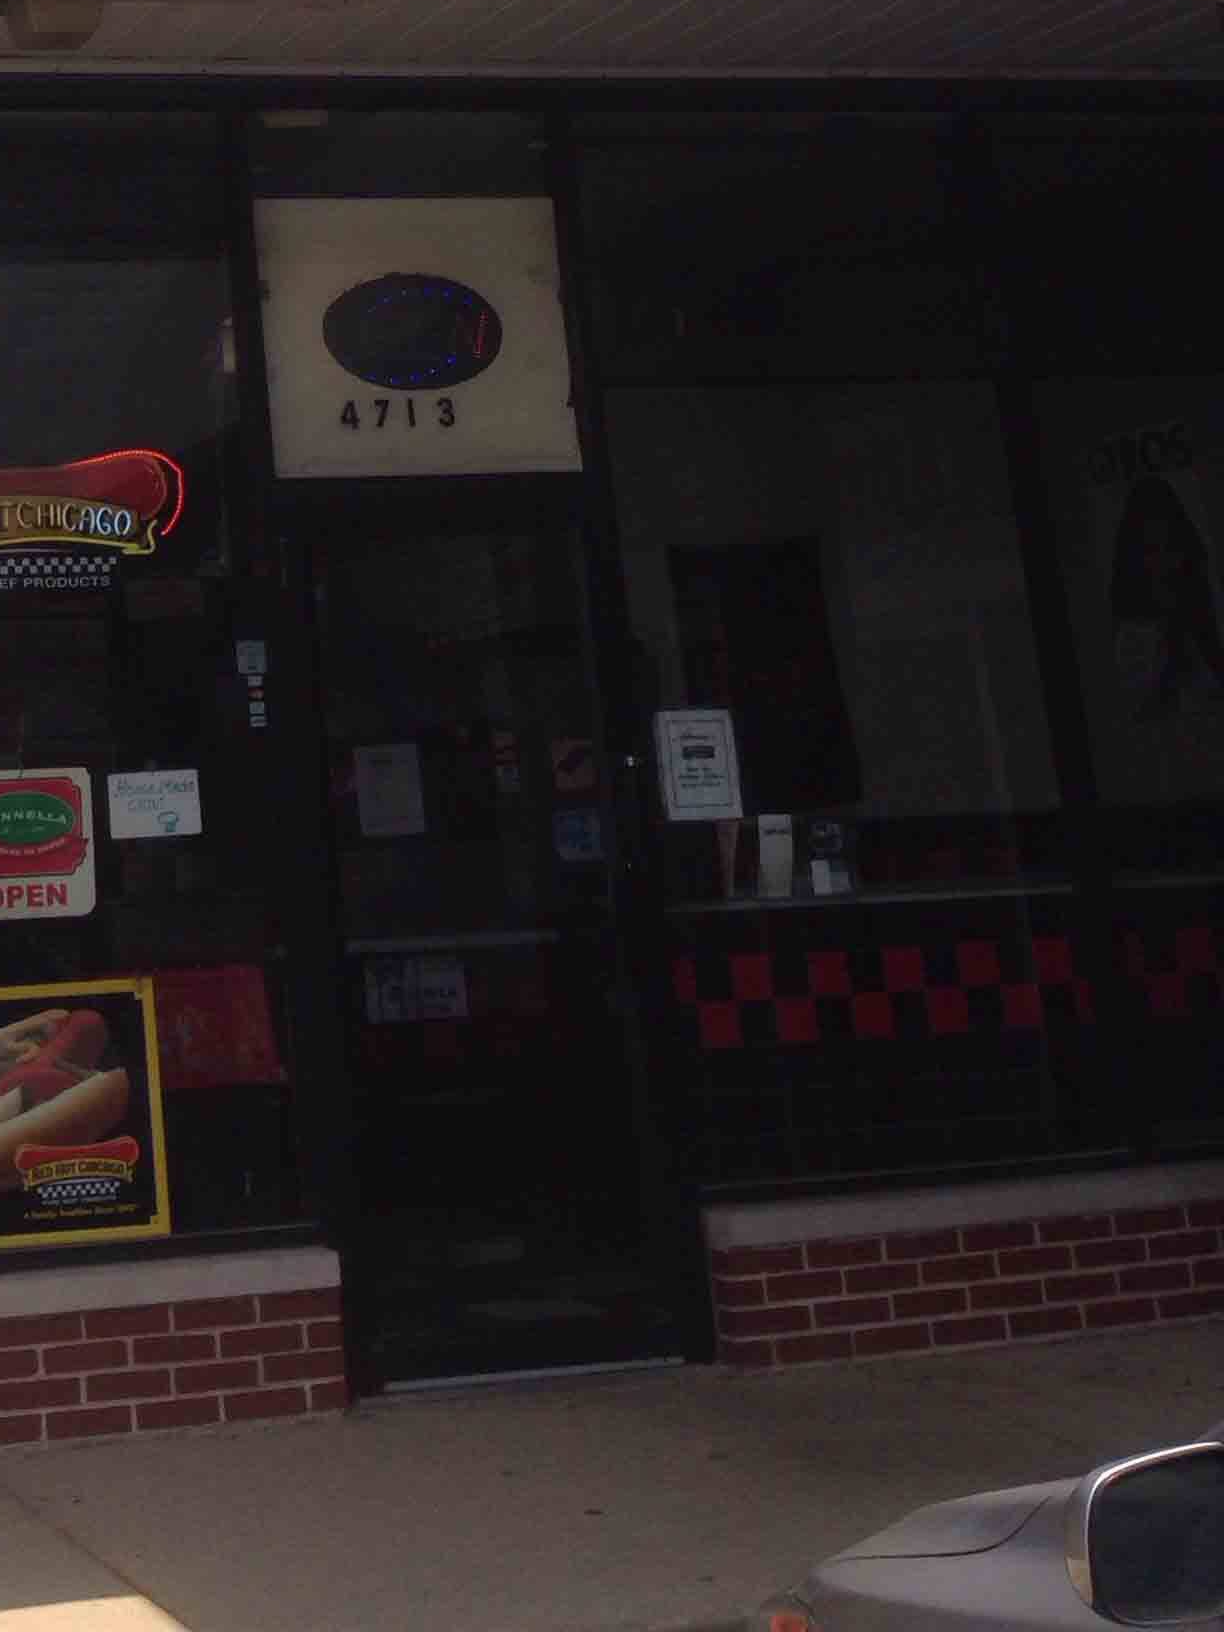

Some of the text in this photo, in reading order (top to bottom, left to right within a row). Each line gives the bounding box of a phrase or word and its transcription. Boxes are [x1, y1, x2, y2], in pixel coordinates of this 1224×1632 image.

[340, 398, 457, 430] 4713
[15, 502, 133, 537] CHICAGO
[22, 574, 113, 590] PRODUCTS
